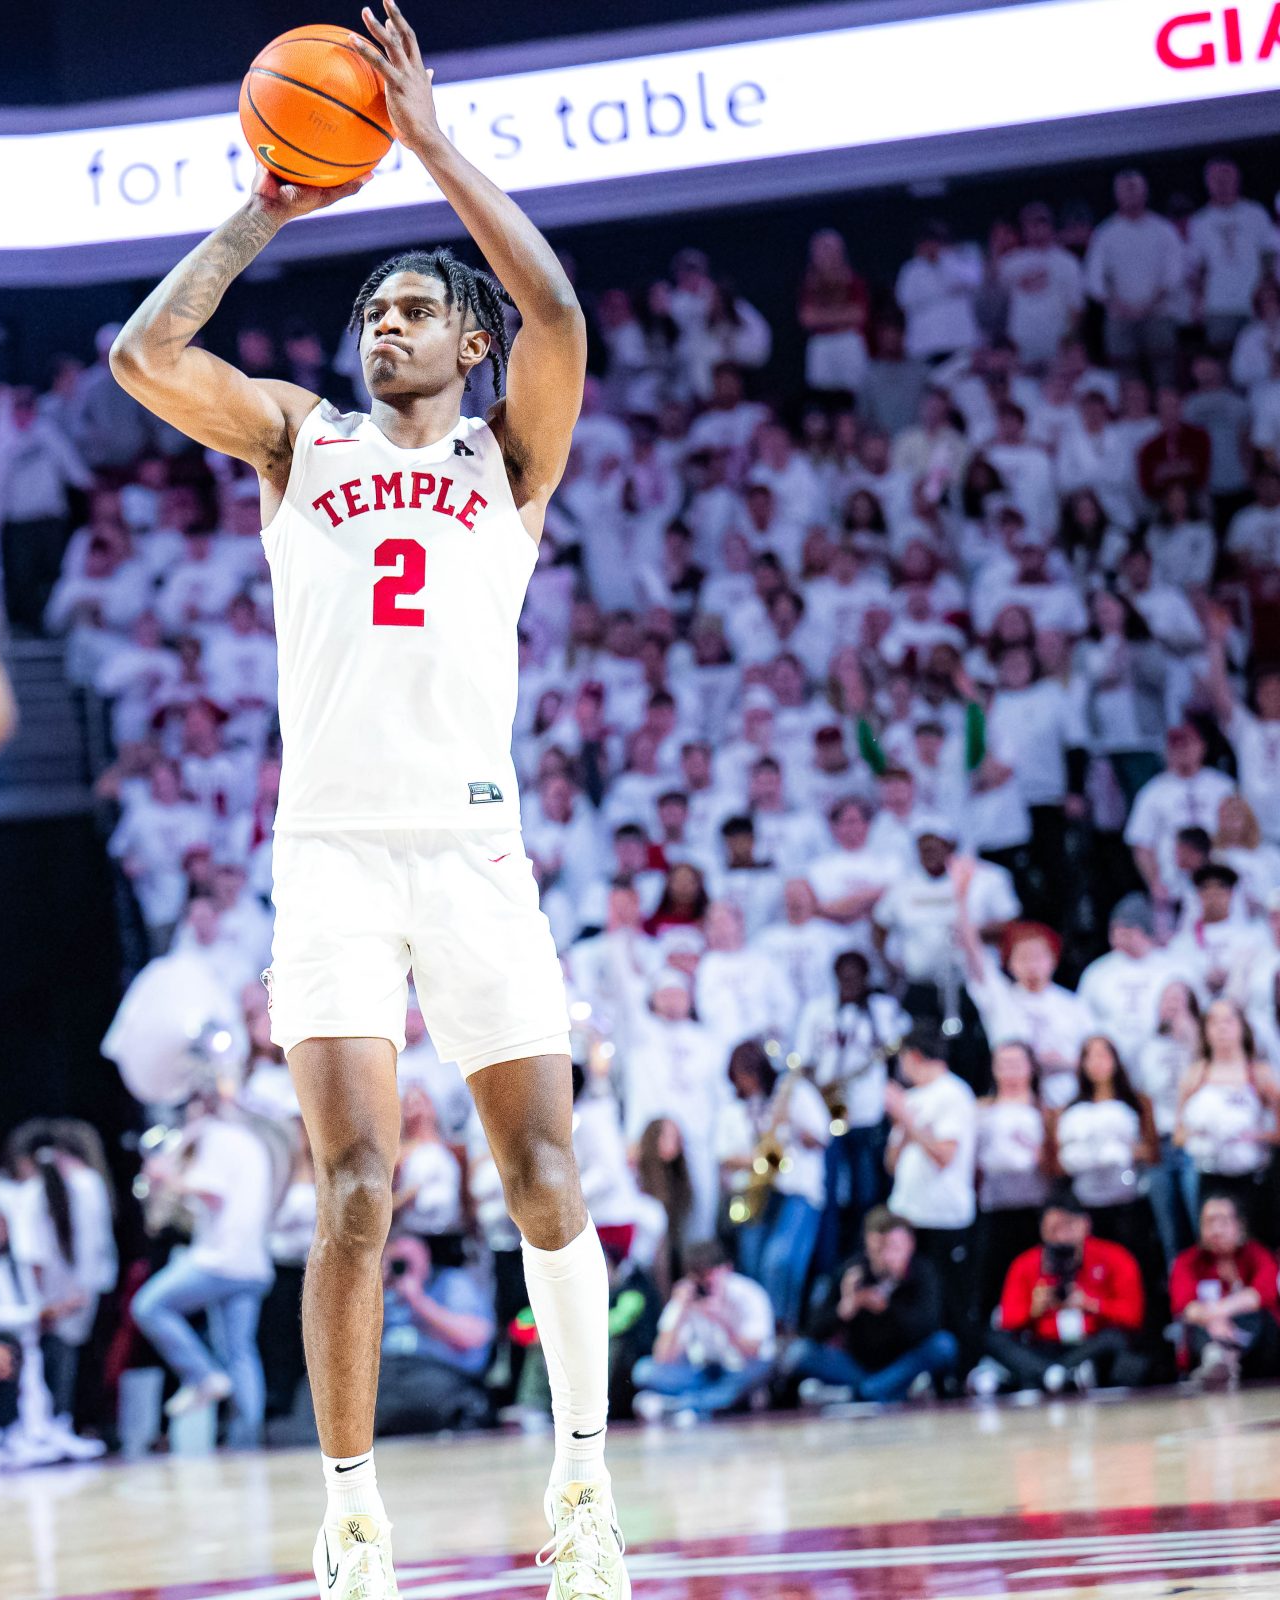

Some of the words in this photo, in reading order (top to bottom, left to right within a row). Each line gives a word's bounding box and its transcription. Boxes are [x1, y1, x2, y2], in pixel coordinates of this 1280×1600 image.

[87, 147, 190, 206] for
[555, 70, 767, 150] table
[311, 471, 488, 531] TEMPLE
[372, 538, 426, 627] 2
